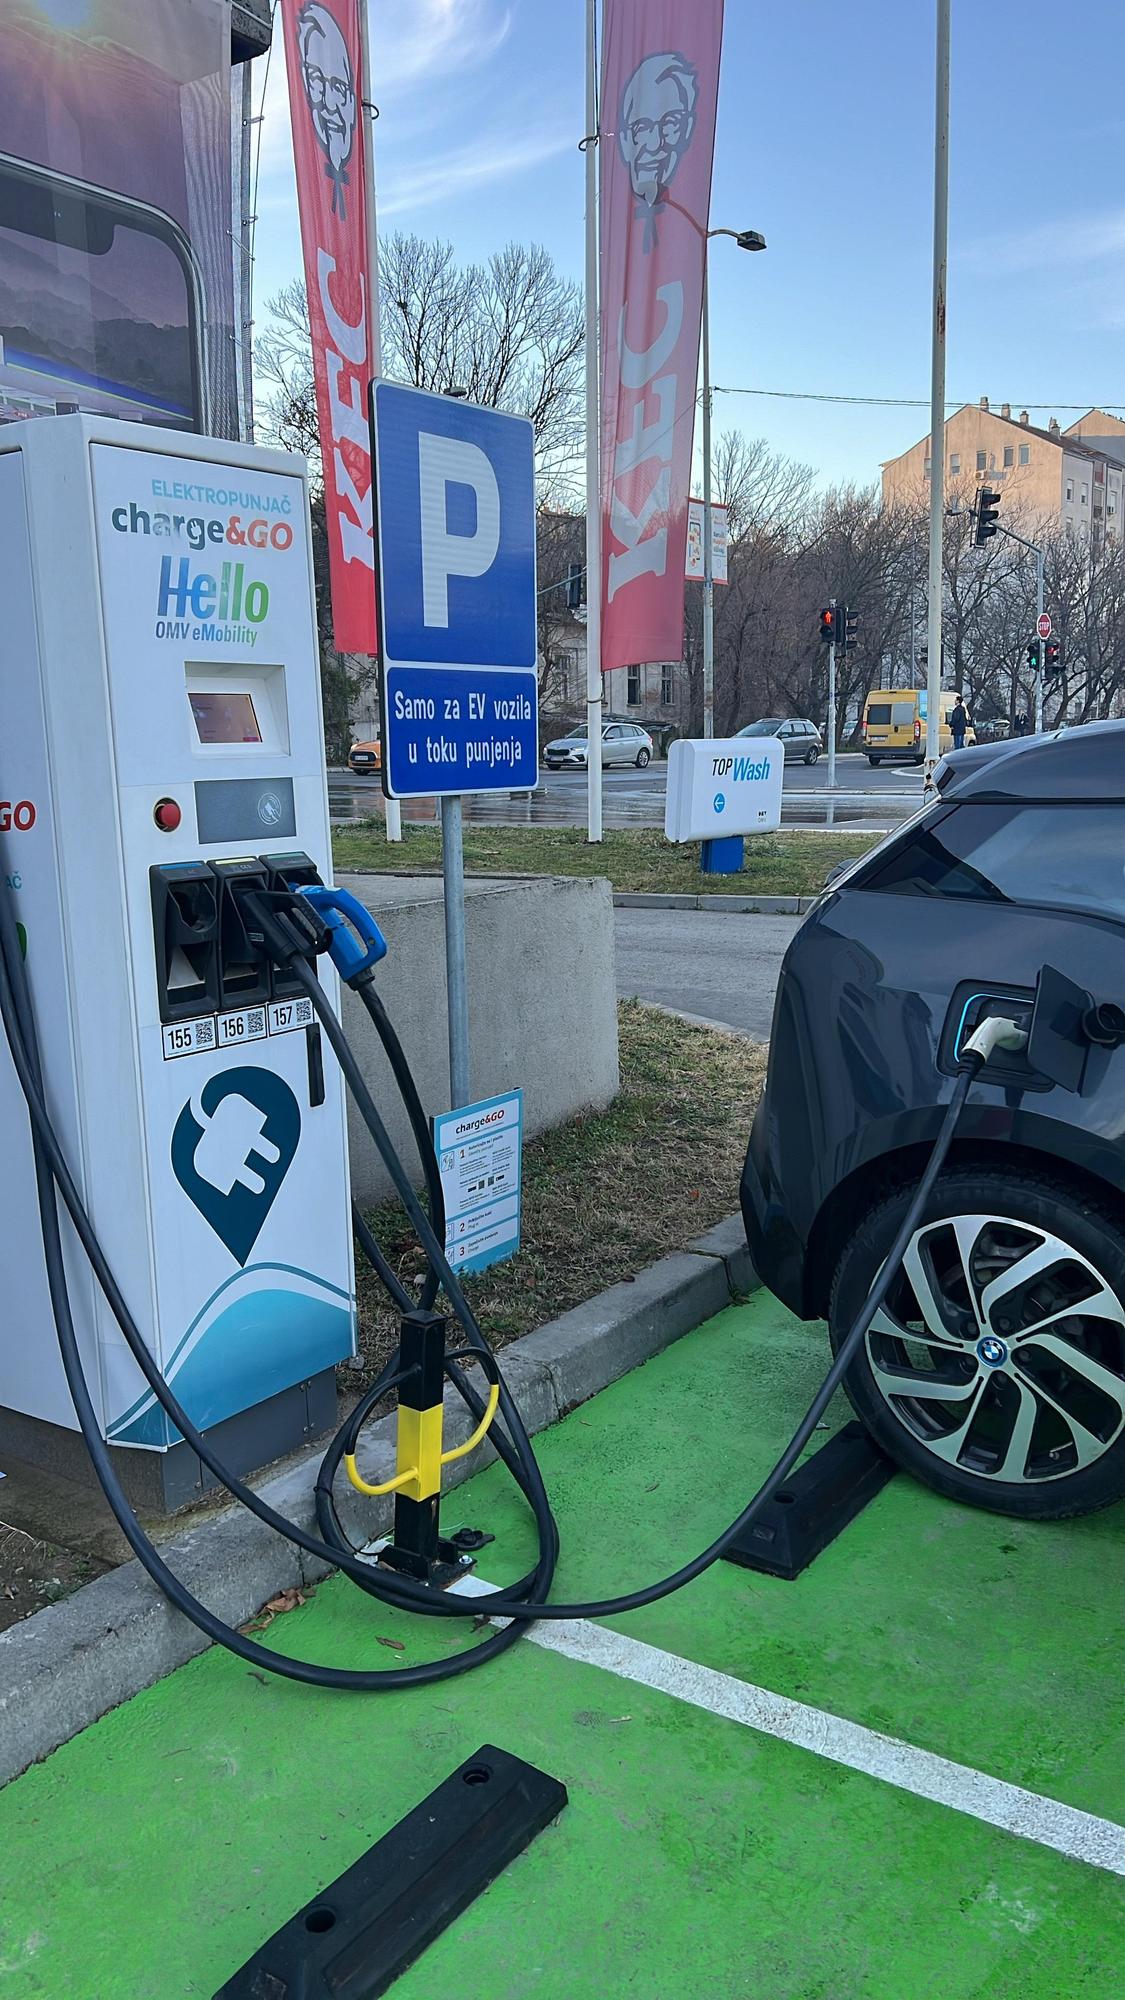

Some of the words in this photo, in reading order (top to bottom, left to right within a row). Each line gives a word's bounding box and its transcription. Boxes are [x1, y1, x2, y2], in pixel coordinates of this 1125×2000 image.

[318, 247, 374, 571] KFC
[151, 479, 292, 514] ELEKTROPUNJAČ
[111, 502, 294, 550] charge&GO
[418, 431, 500, 628] P
[156, 555, 270, 623] Hello
[155, 621, 190, 640] OMV
[192, 623, 258, 647] eMobility
[394, 690, 435, 720] Samo
[444, 699, 460, 720] za
[468, 692, 486, 720] EV
[494, 694, 531, 720] vozila
[408, 743, 418, 764] u
[426, 735, 457, 763] toku
[466, 736, 522, 769] punjenja
[221, 1016, 244, 1039] 156
[272, 1005, 293, 1027] 157
[167, 1027, 192, 1050] 155
[455, 1109, 505, 1135] charge&GO
[459, 1222, 466, 1233] 2
[459, 1246, 465, 1257] 3
